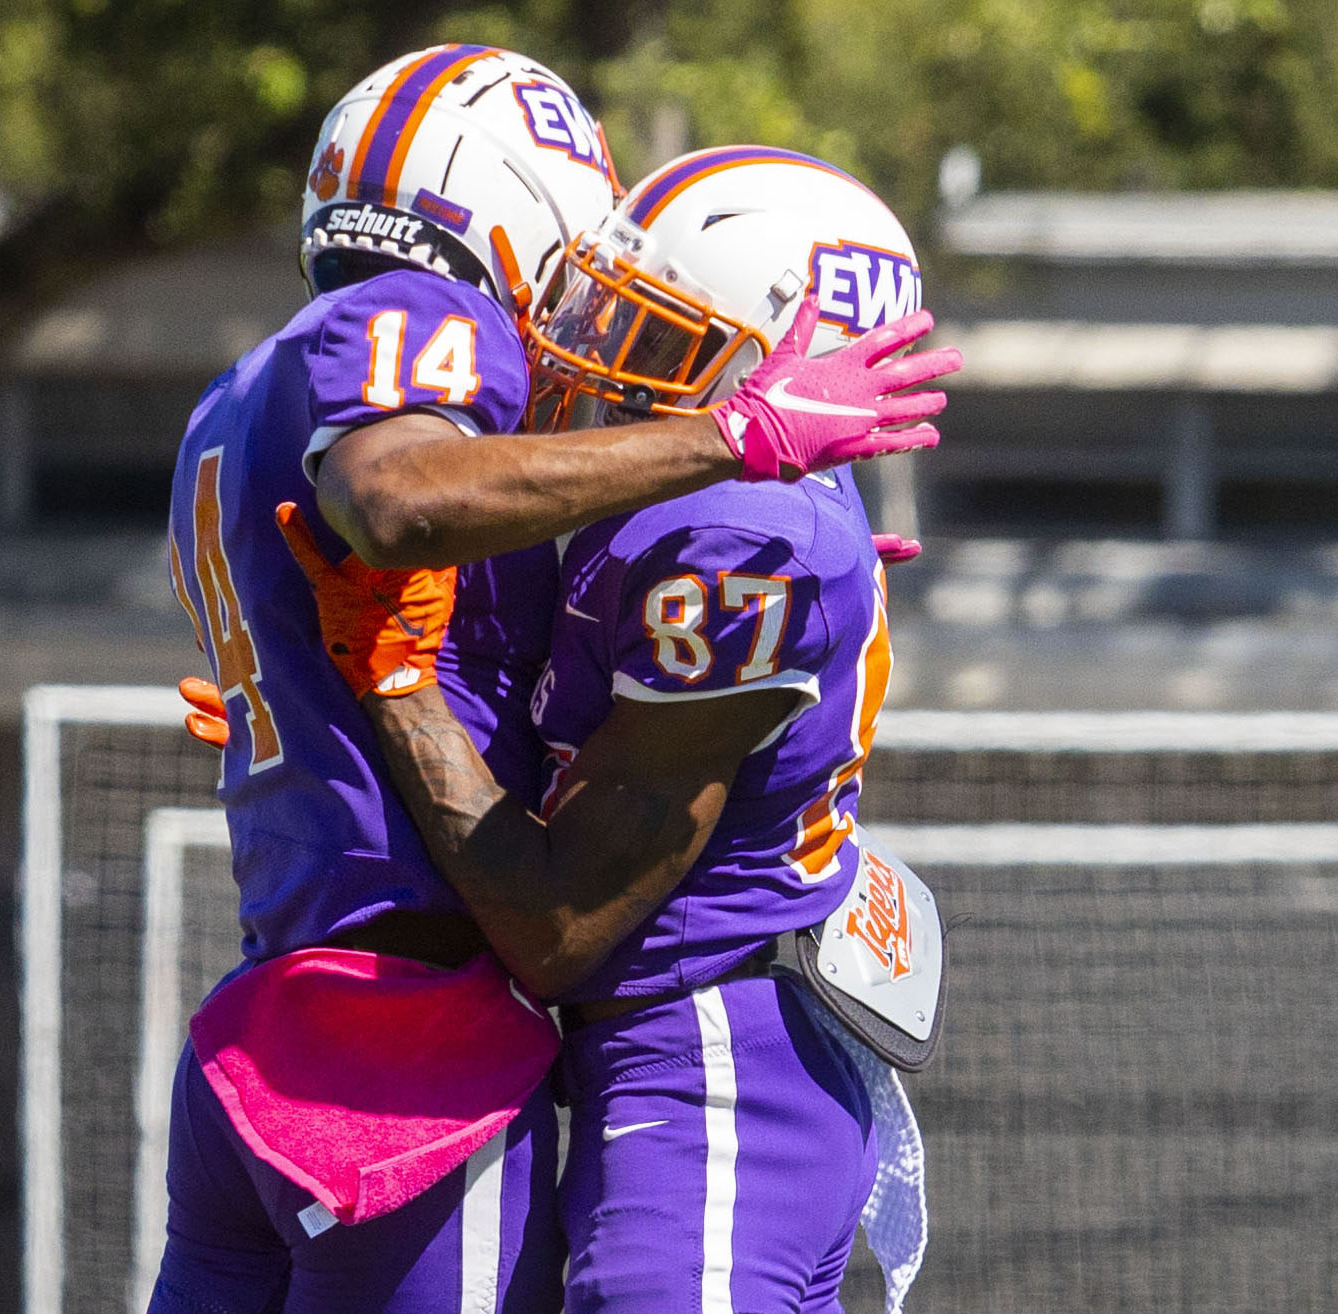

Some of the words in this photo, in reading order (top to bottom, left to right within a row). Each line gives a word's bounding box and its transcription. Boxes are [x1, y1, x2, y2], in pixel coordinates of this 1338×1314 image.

[326, 203, 424, 243] schutt
[362, 310, 480, 410] 14
[169, 445, 284, 790] 4
[642, 571, 791, 684] 87
[845, 849, 911, 981] Tigers
